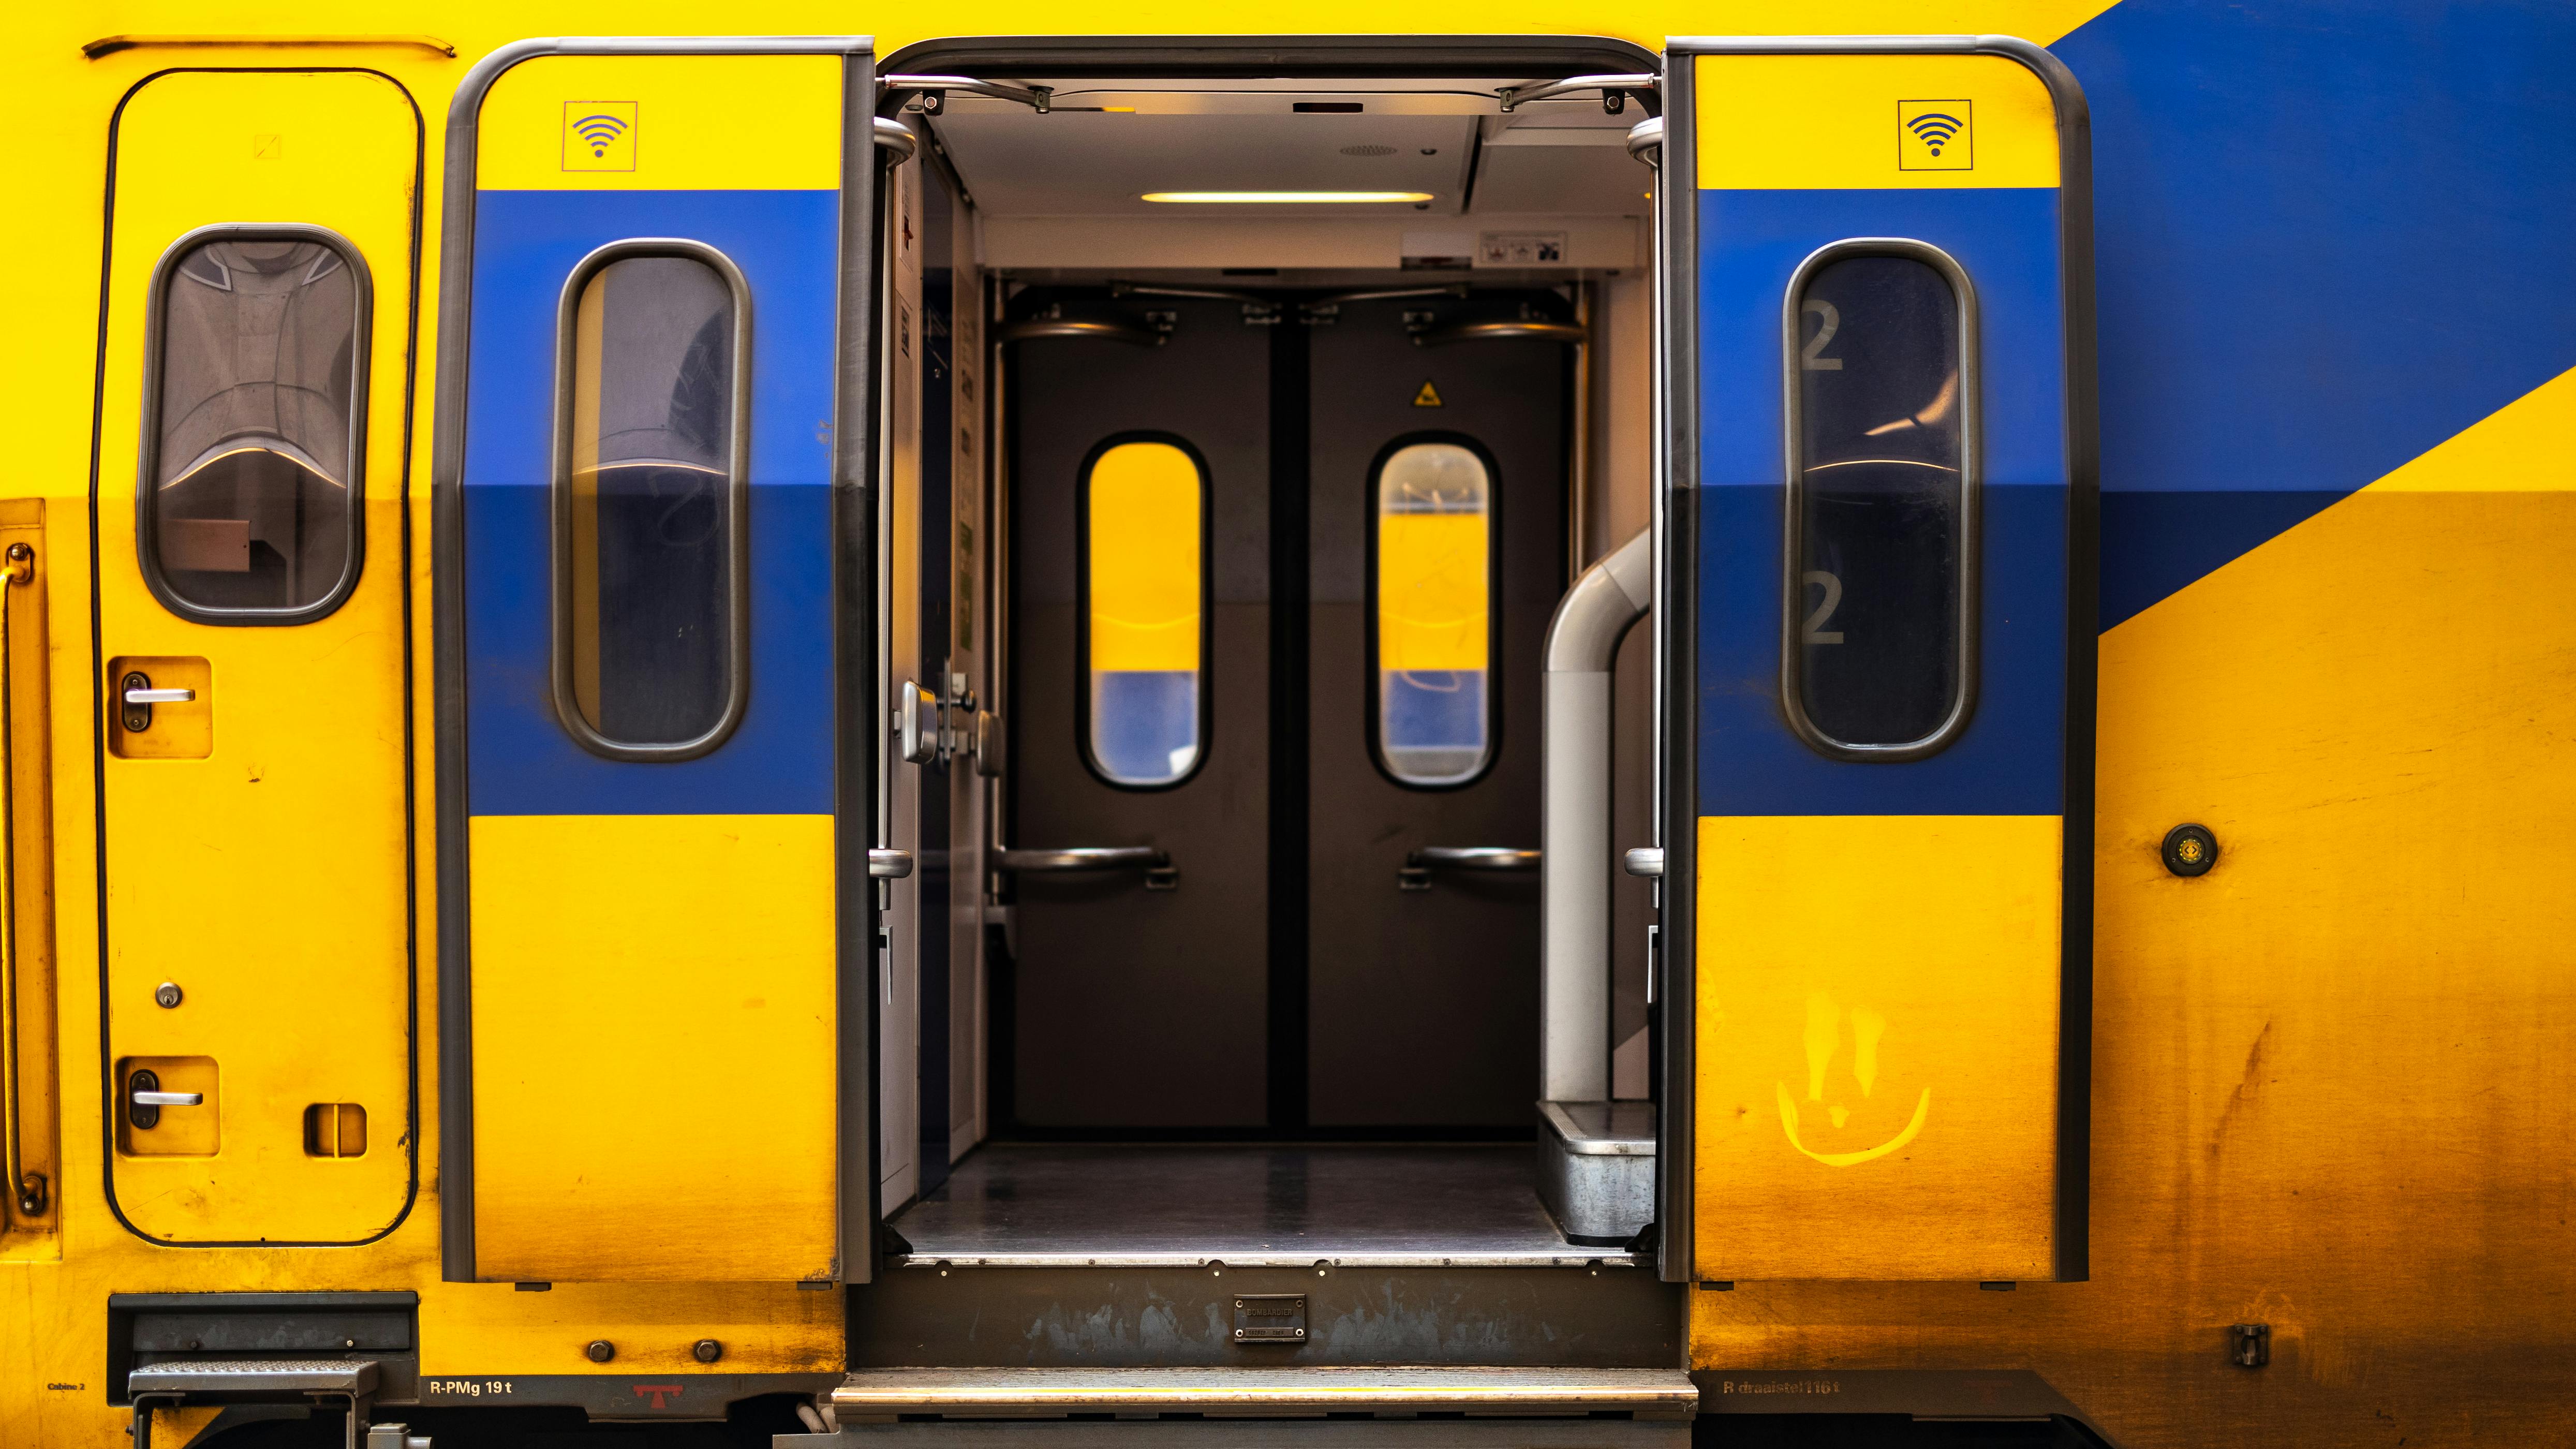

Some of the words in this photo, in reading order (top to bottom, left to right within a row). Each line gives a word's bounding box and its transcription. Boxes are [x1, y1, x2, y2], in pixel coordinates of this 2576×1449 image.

[1801, 300, 1843, 370] 2
[1801, 570, 1844, 644] 2
[431, 1381, 480, 1396] R-PMg
[485, 1381, 502, 1393] 19
[505, 1382, 512, 1393] t
[1724, 1381, 1734, 1394] R
[1738, 1380, 1803, 1394] draaistel
